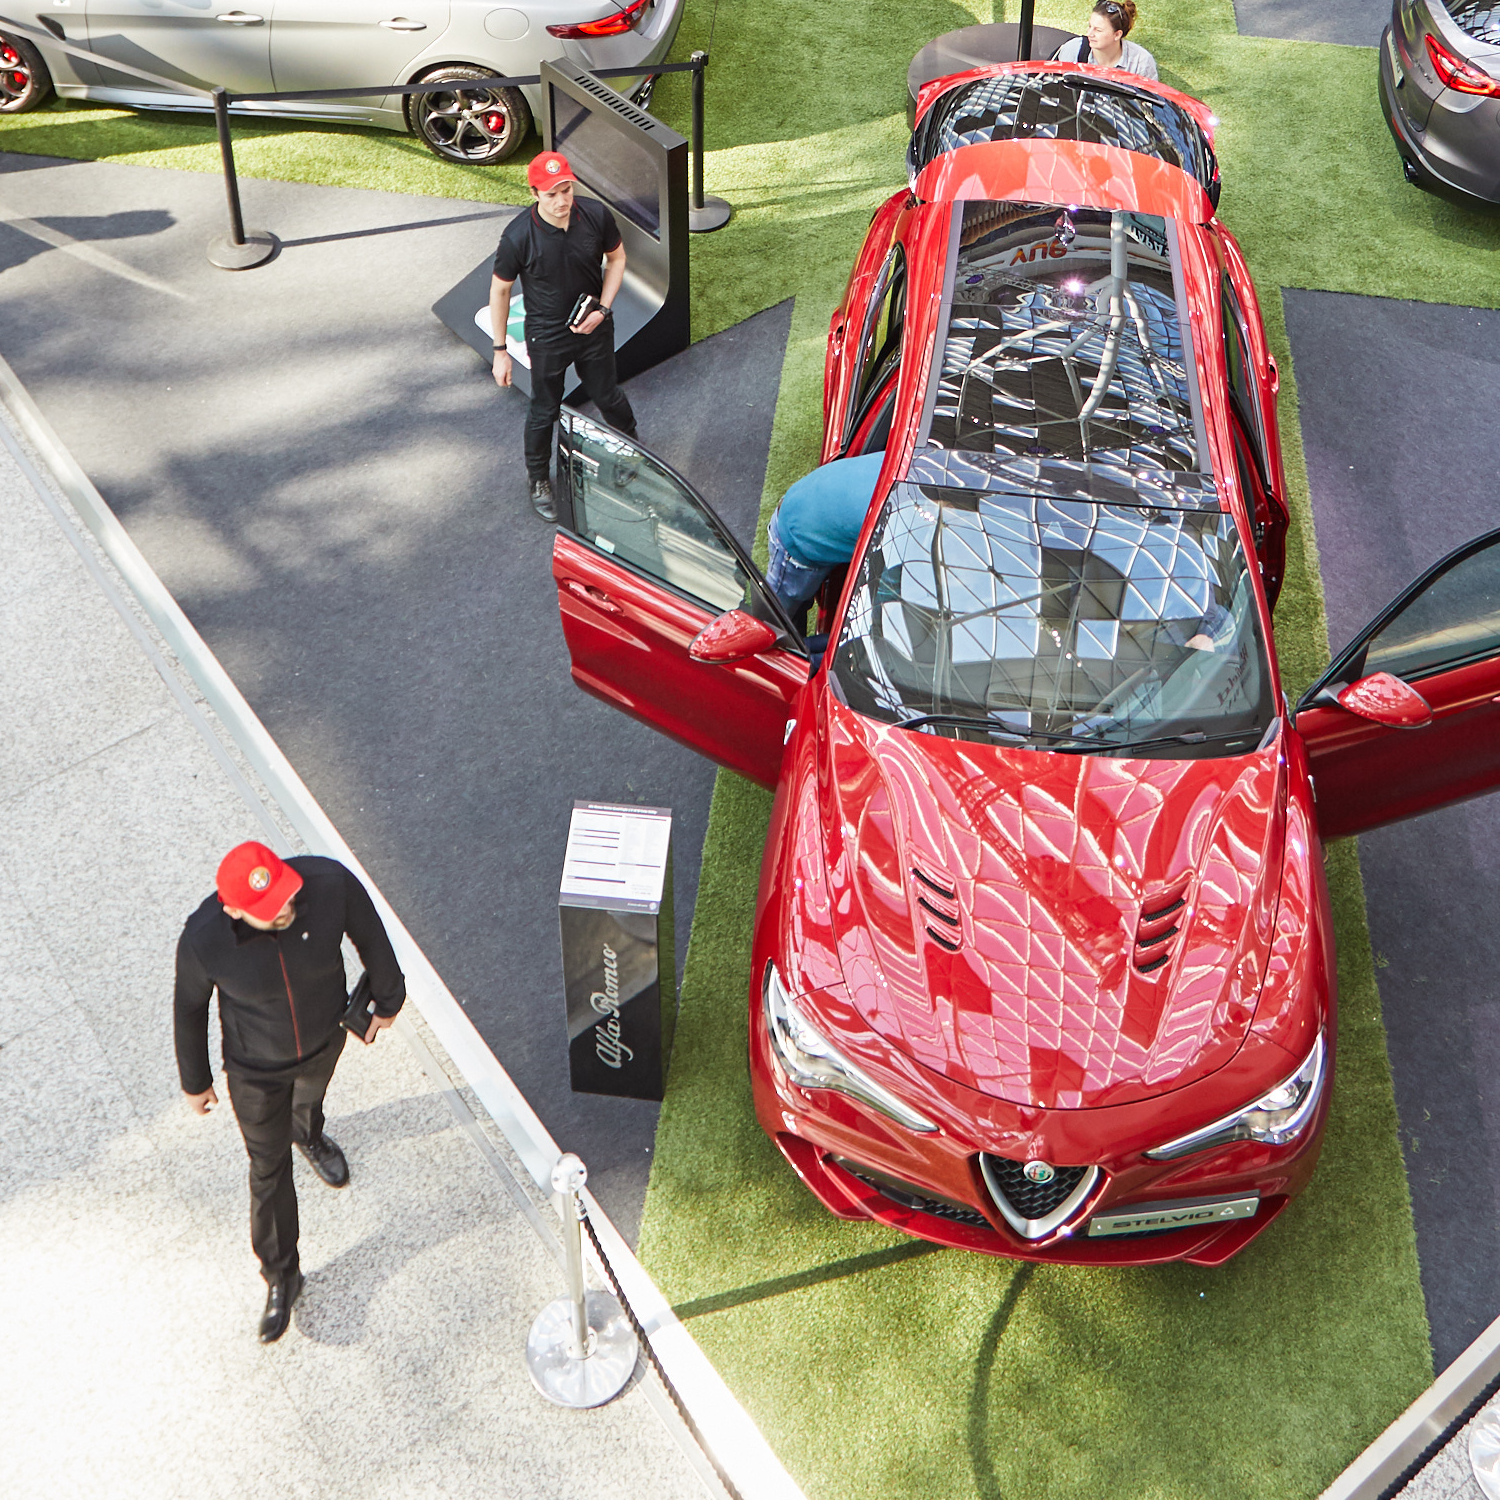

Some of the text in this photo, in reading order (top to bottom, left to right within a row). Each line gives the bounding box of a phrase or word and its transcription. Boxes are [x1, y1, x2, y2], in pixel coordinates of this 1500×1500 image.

[590, 943, 633, 1069] Alfa Romeo
[1112, 1211, 1214, 1229] STELVIO
